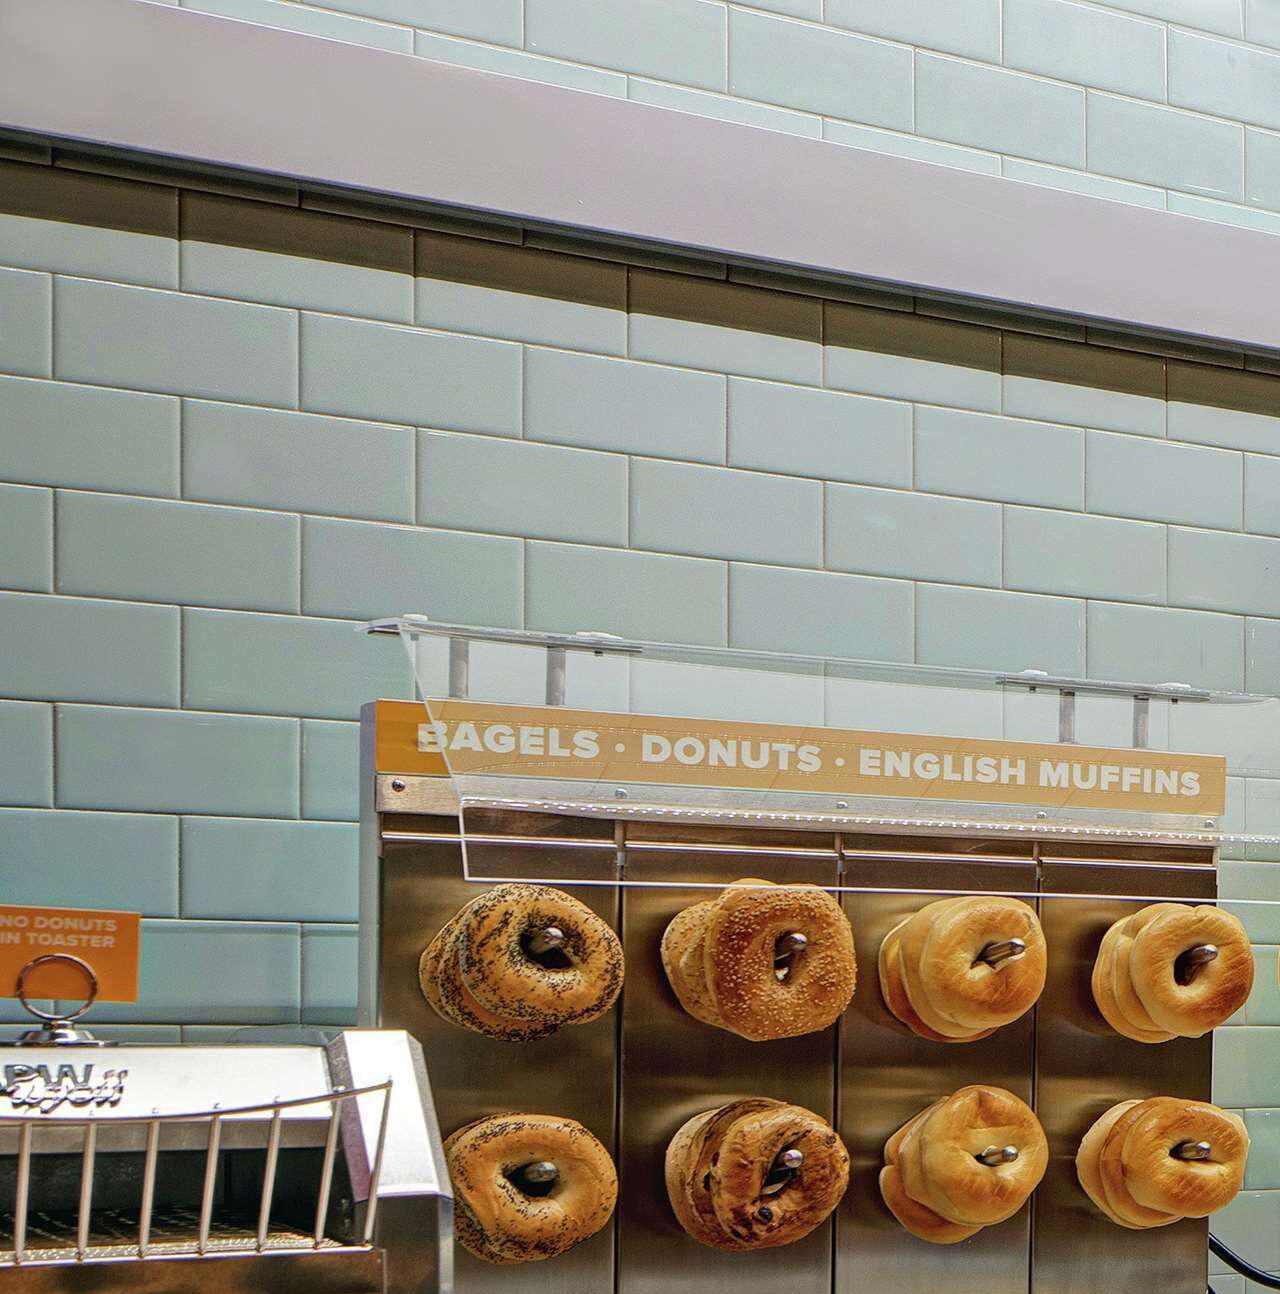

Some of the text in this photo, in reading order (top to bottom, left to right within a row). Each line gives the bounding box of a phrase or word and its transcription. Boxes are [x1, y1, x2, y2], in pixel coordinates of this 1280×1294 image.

[417, 720, 1201, 796] BAGELS DONUTS ENGLISH MUFFINS
[33, 916, 118, 932] DONUTS
[26, 932, 115, 948] TOASTER
